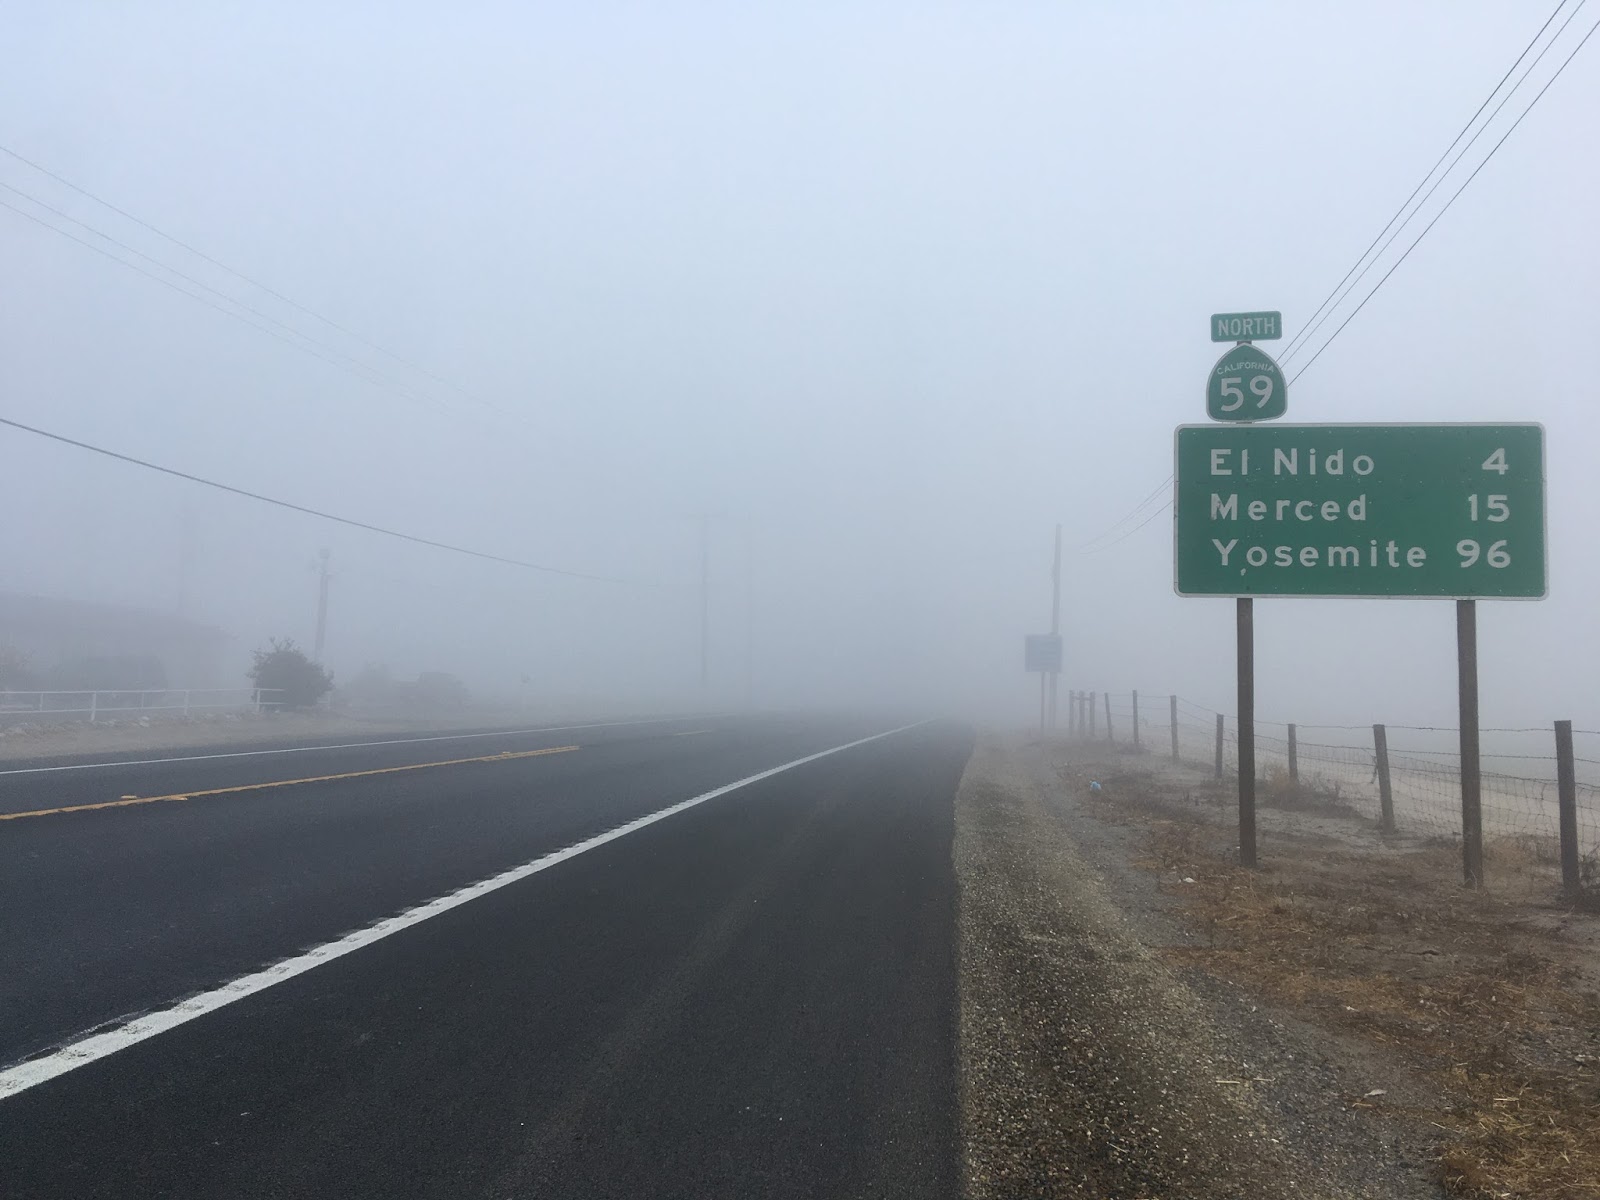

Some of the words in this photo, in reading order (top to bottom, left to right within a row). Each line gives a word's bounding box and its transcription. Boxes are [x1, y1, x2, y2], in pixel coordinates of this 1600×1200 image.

[1217, 316, 1275, 336] NORTH
[1216, 361, 1275, 375] CALIFORNIA
[1220, 375, 1274, 412] 59
[1210, 448, 1248, 475] El
[1273, 448, 1375, 475] Nido
[1481, 447, 1509, 475] 4
[1210, 493, 1368, 521] Merced
[1467, 494, 1511, 522] 15
[1211, 538, 1427, 568] Yosemite
[1455, 539, 1512, 569] 96
